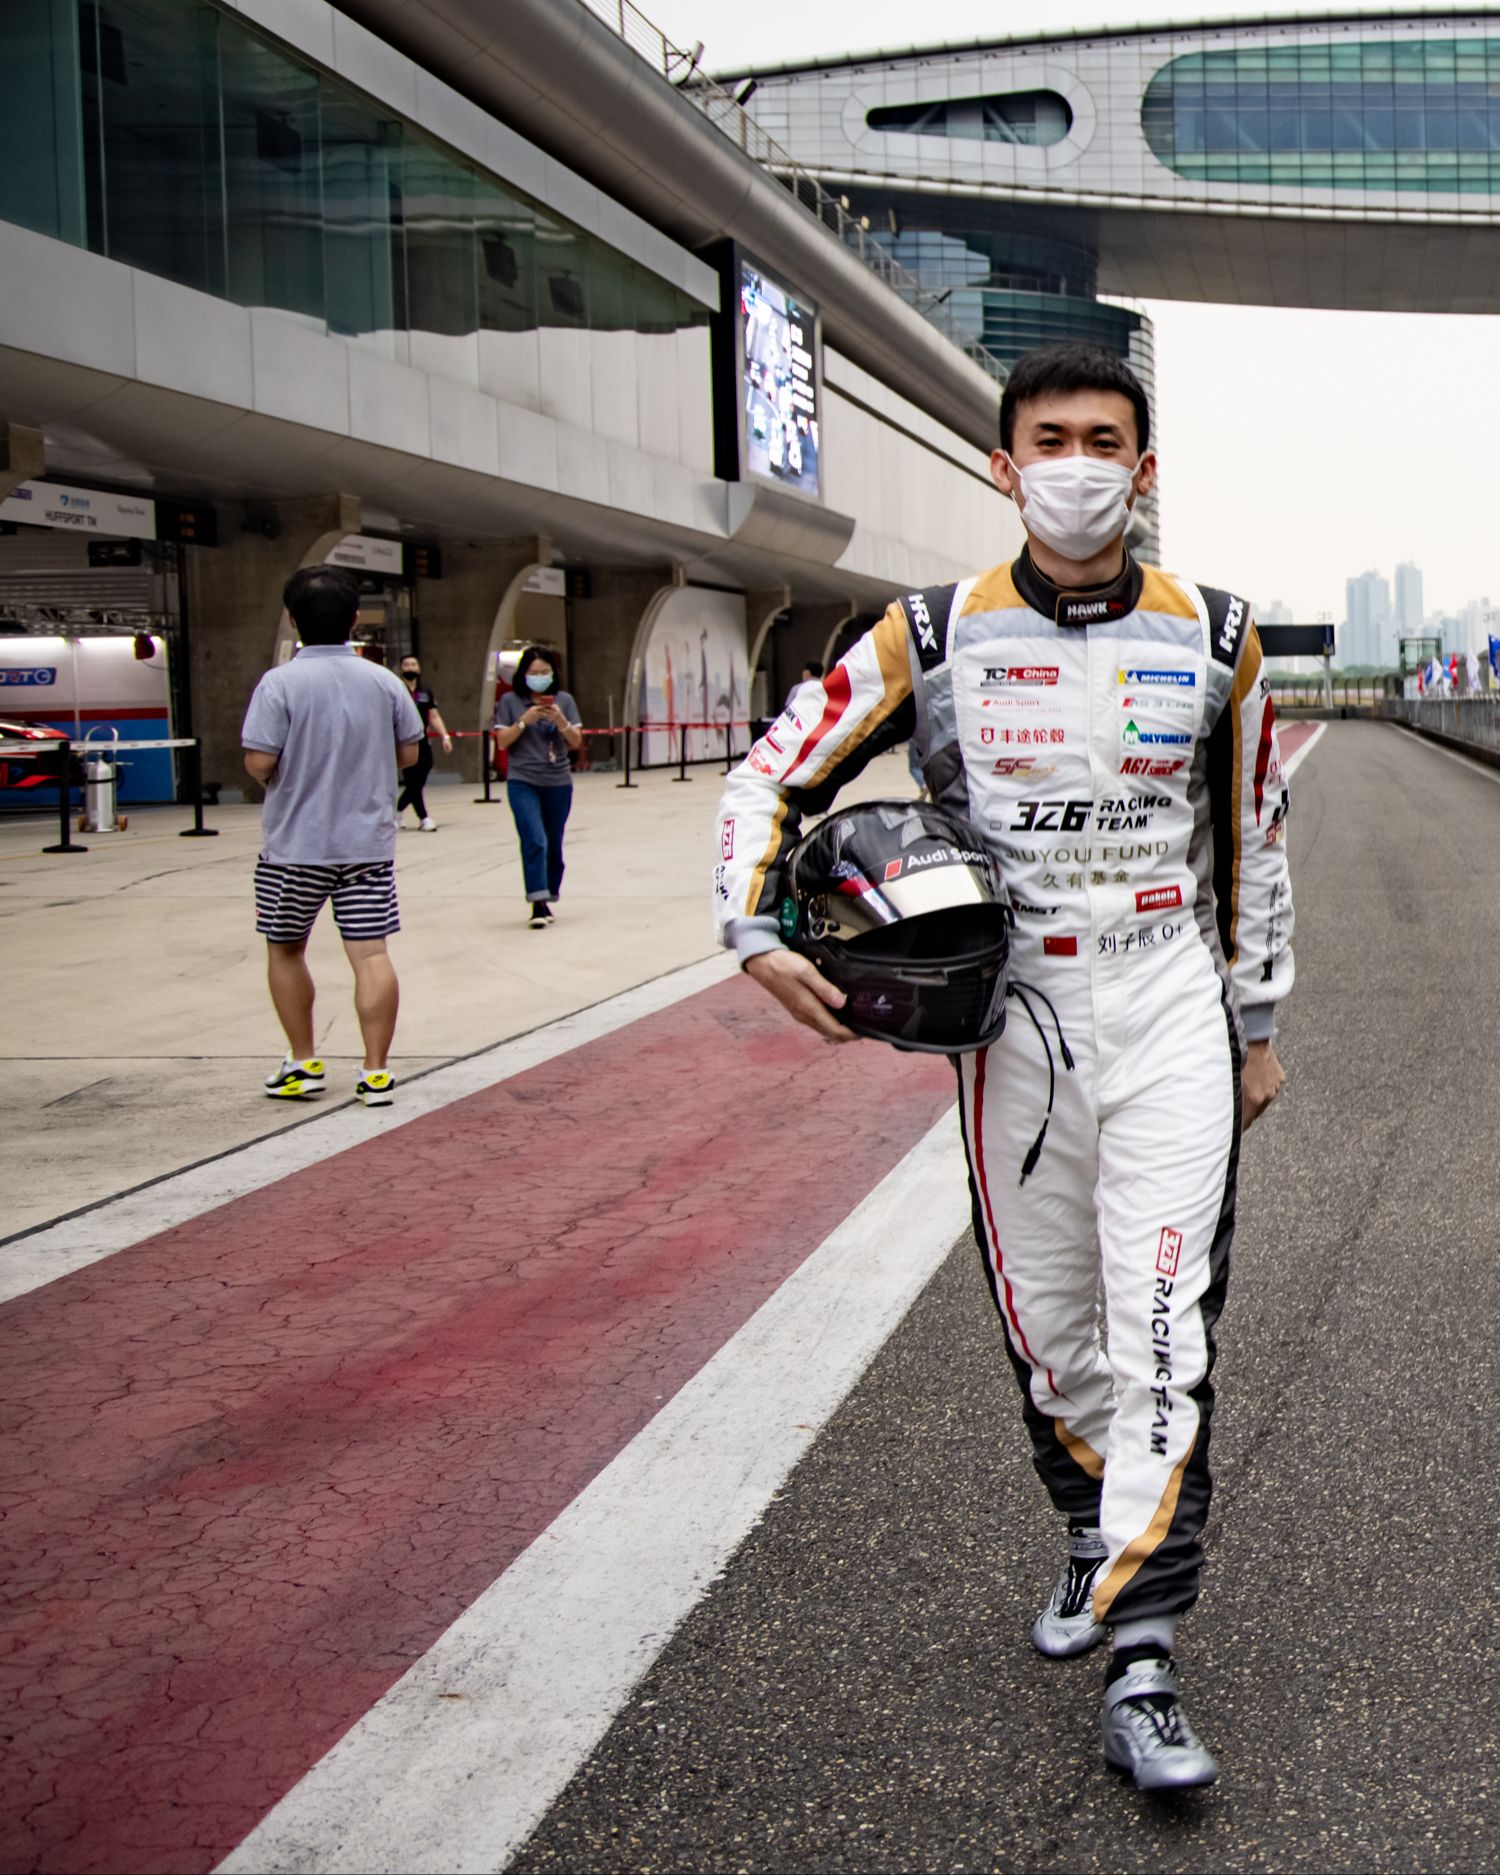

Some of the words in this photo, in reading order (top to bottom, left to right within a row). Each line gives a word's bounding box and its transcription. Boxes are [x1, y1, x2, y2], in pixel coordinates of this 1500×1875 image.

[1067, 601, 1108, 616] HAWK
[909, 594, 938, 650] HRX
[1219, 595, 1243, 652] HRX
[1023, 669, 1057, 679] China
[1141, 673, 1190, 684] MICHELIN
[1015, 699, 1040, 708] Sport
[1100, 795, 1172, 812] RACING
[1010, 800, 1093, 832] 326
[723, 820, 734, 860] 326
[907, 850, 948, 869] Audi
[950, 848, 989, 866] Sport
[1103, 841, 1169, 861] FUND
[1043, 869, 1130, 889] 久有基金
[1157, 1227, 1182, 1277] 326
[1150, 1277, 1173, 1382] RACING
[1150, 1384, 1173, 1457] TEAM
